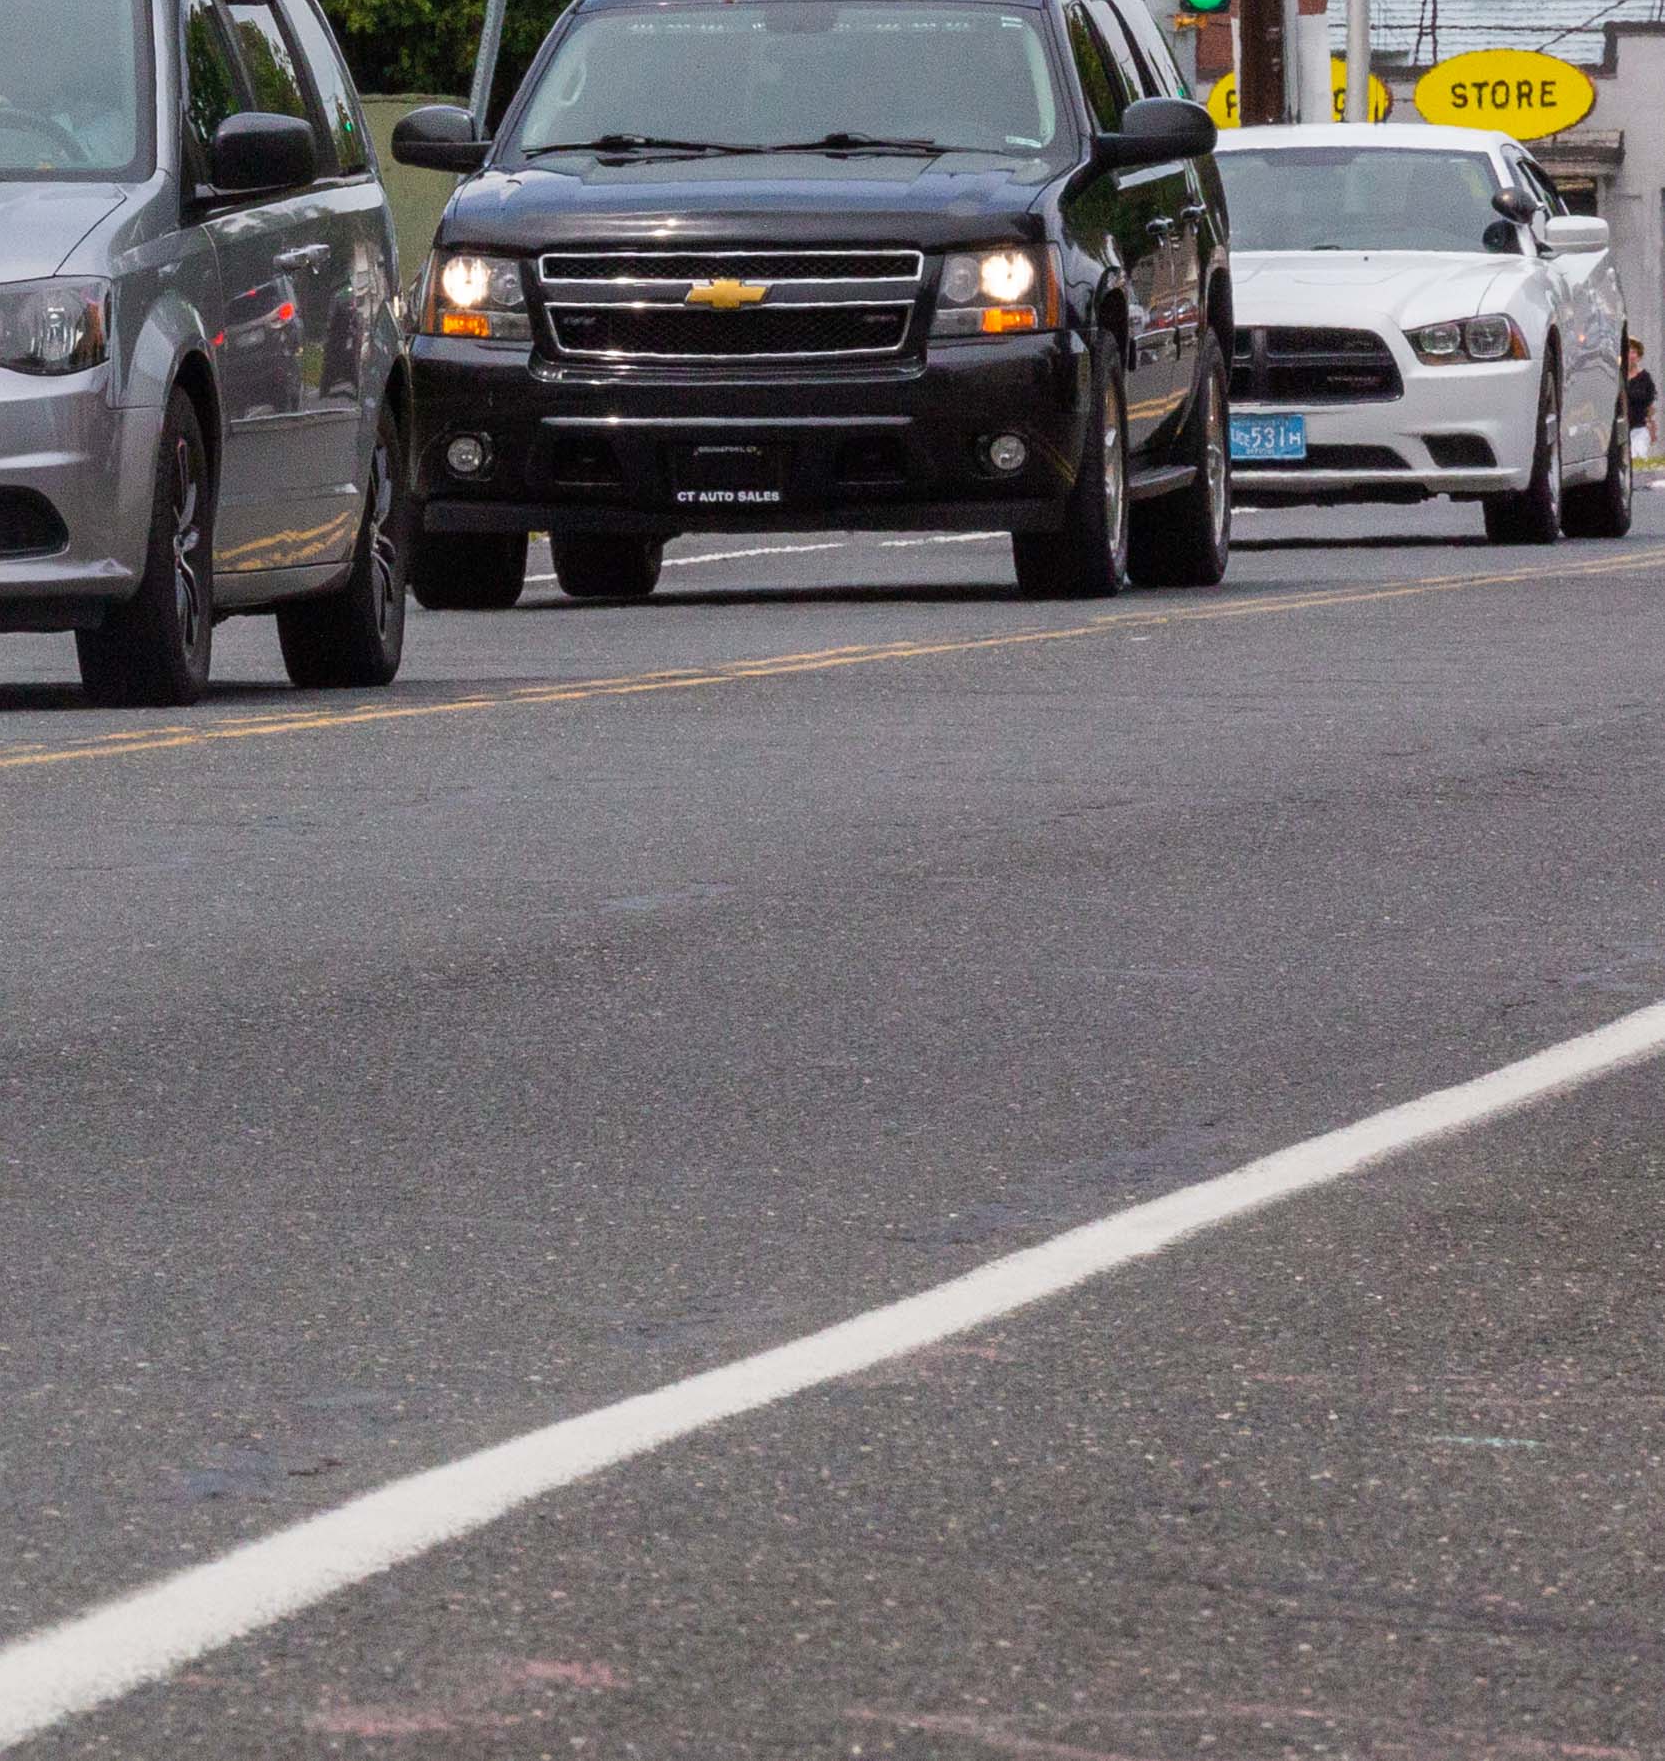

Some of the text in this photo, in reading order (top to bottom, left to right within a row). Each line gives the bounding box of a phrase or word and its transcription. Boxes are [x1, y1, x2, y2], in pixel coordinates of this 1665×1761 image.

[1450, 79, 1559, 110] STORE
[677, 491, 781, 502] CT AUTO SALES
